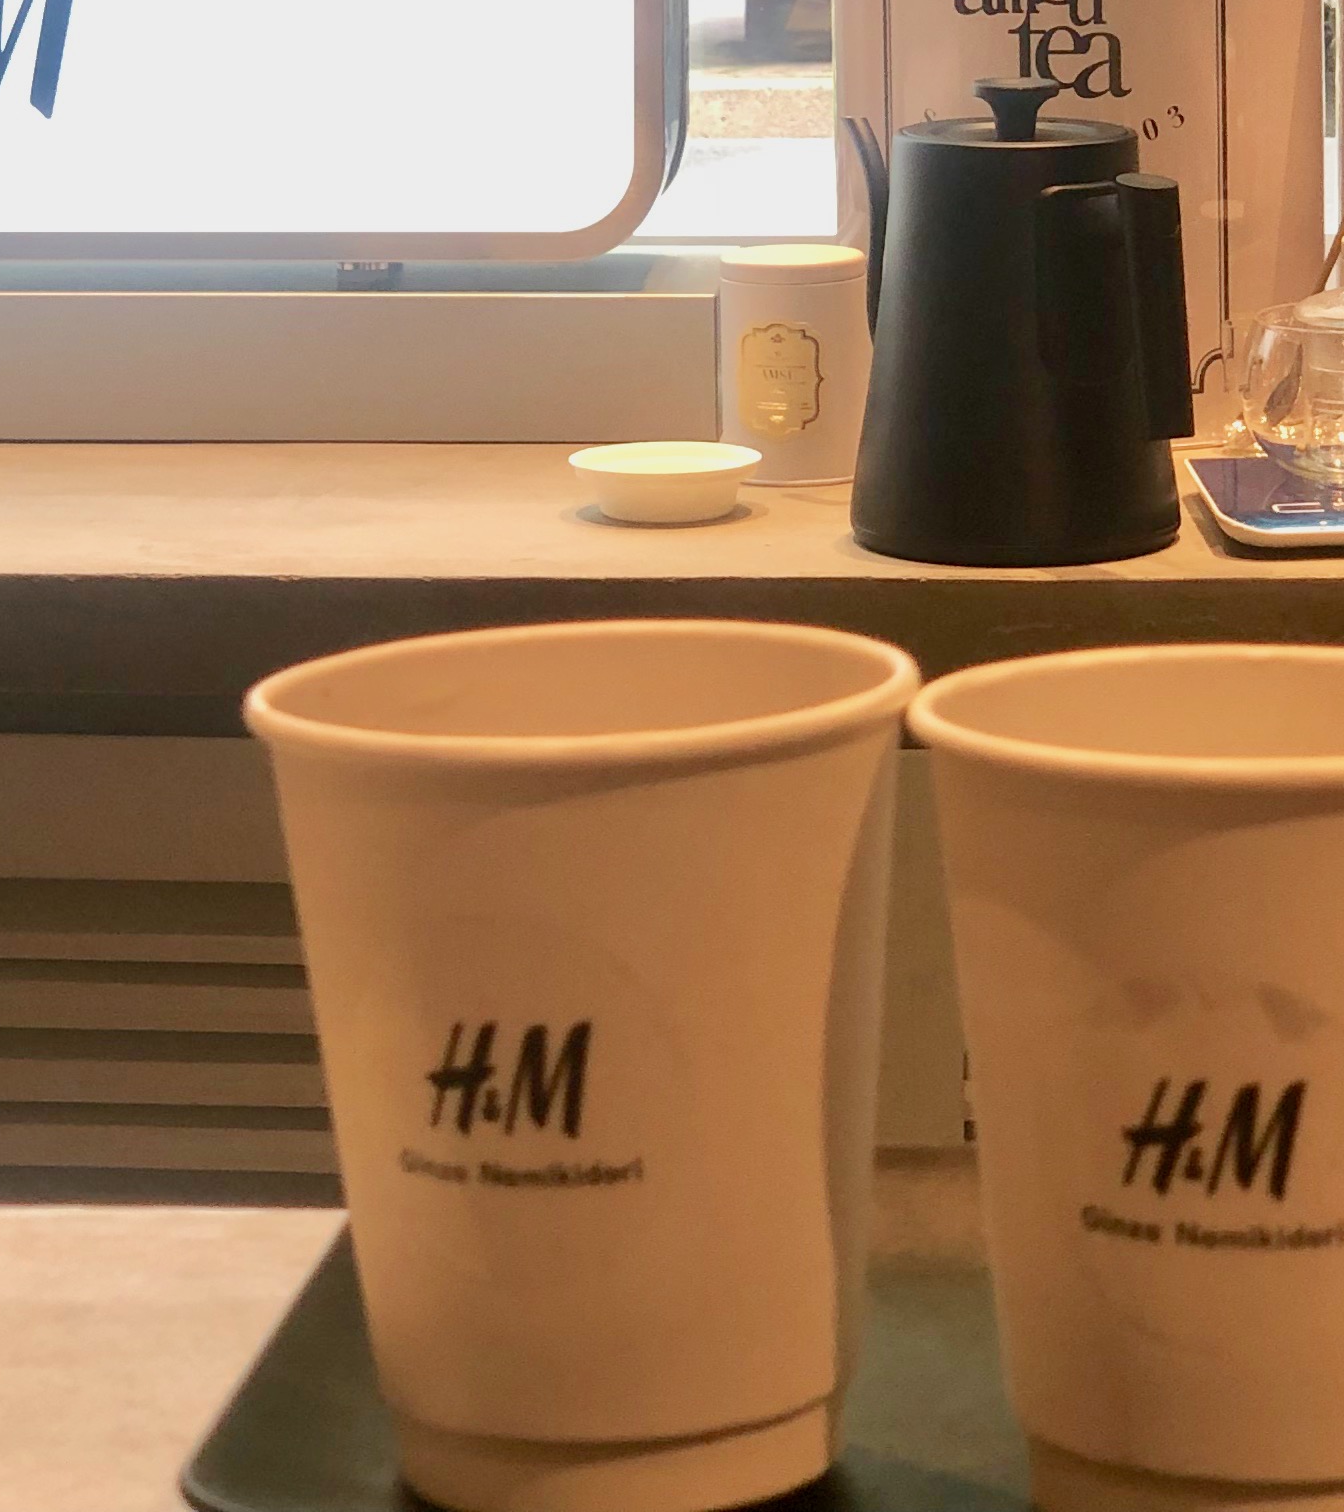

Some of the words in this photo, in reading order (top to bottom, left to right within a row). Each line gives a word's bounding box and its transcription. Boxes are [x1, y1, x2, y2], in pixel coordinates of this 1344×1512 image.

[1008, 12, 1133, 99] tea
[1142, 104, 1186, 141] 03
[425, 1019, 593, 1138] H&M
[1122, 1078, 1308, 1201] H&M
